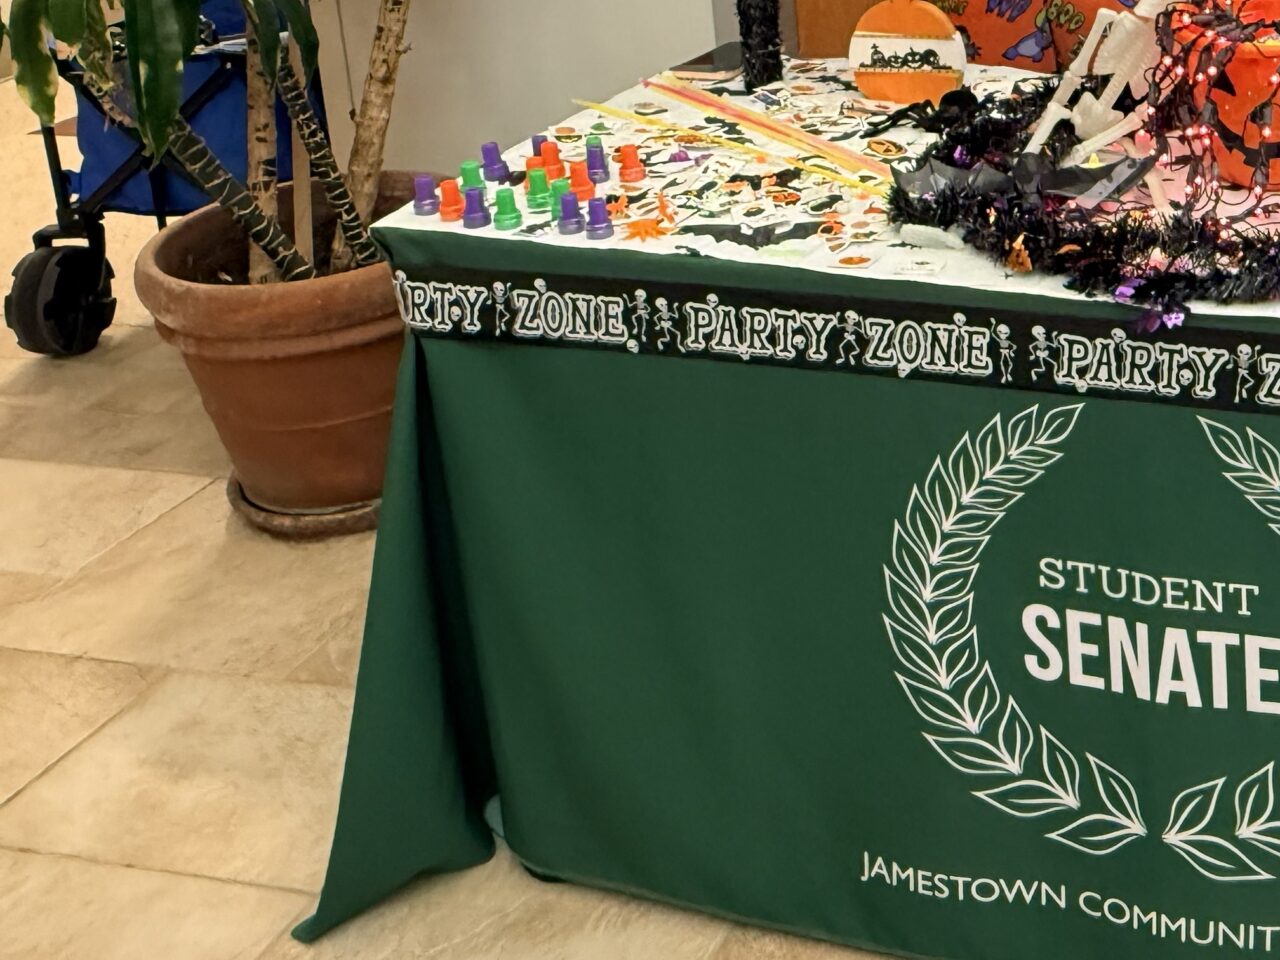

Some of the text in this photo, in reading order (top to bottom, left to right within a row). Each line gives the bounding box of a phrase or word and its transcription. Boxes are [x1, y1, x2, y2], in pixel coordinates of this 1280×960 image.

[513, 288, 628, 344] ZONE
[684, 301, 837, 361] PARTY
[863, 317, 992, 376] ZONE
[1055, 333, 1229, 399] PARTY
[1039, 557, 1259, 616] STUDENT
[860, 851, 1067, 909] JAMESTOWN
